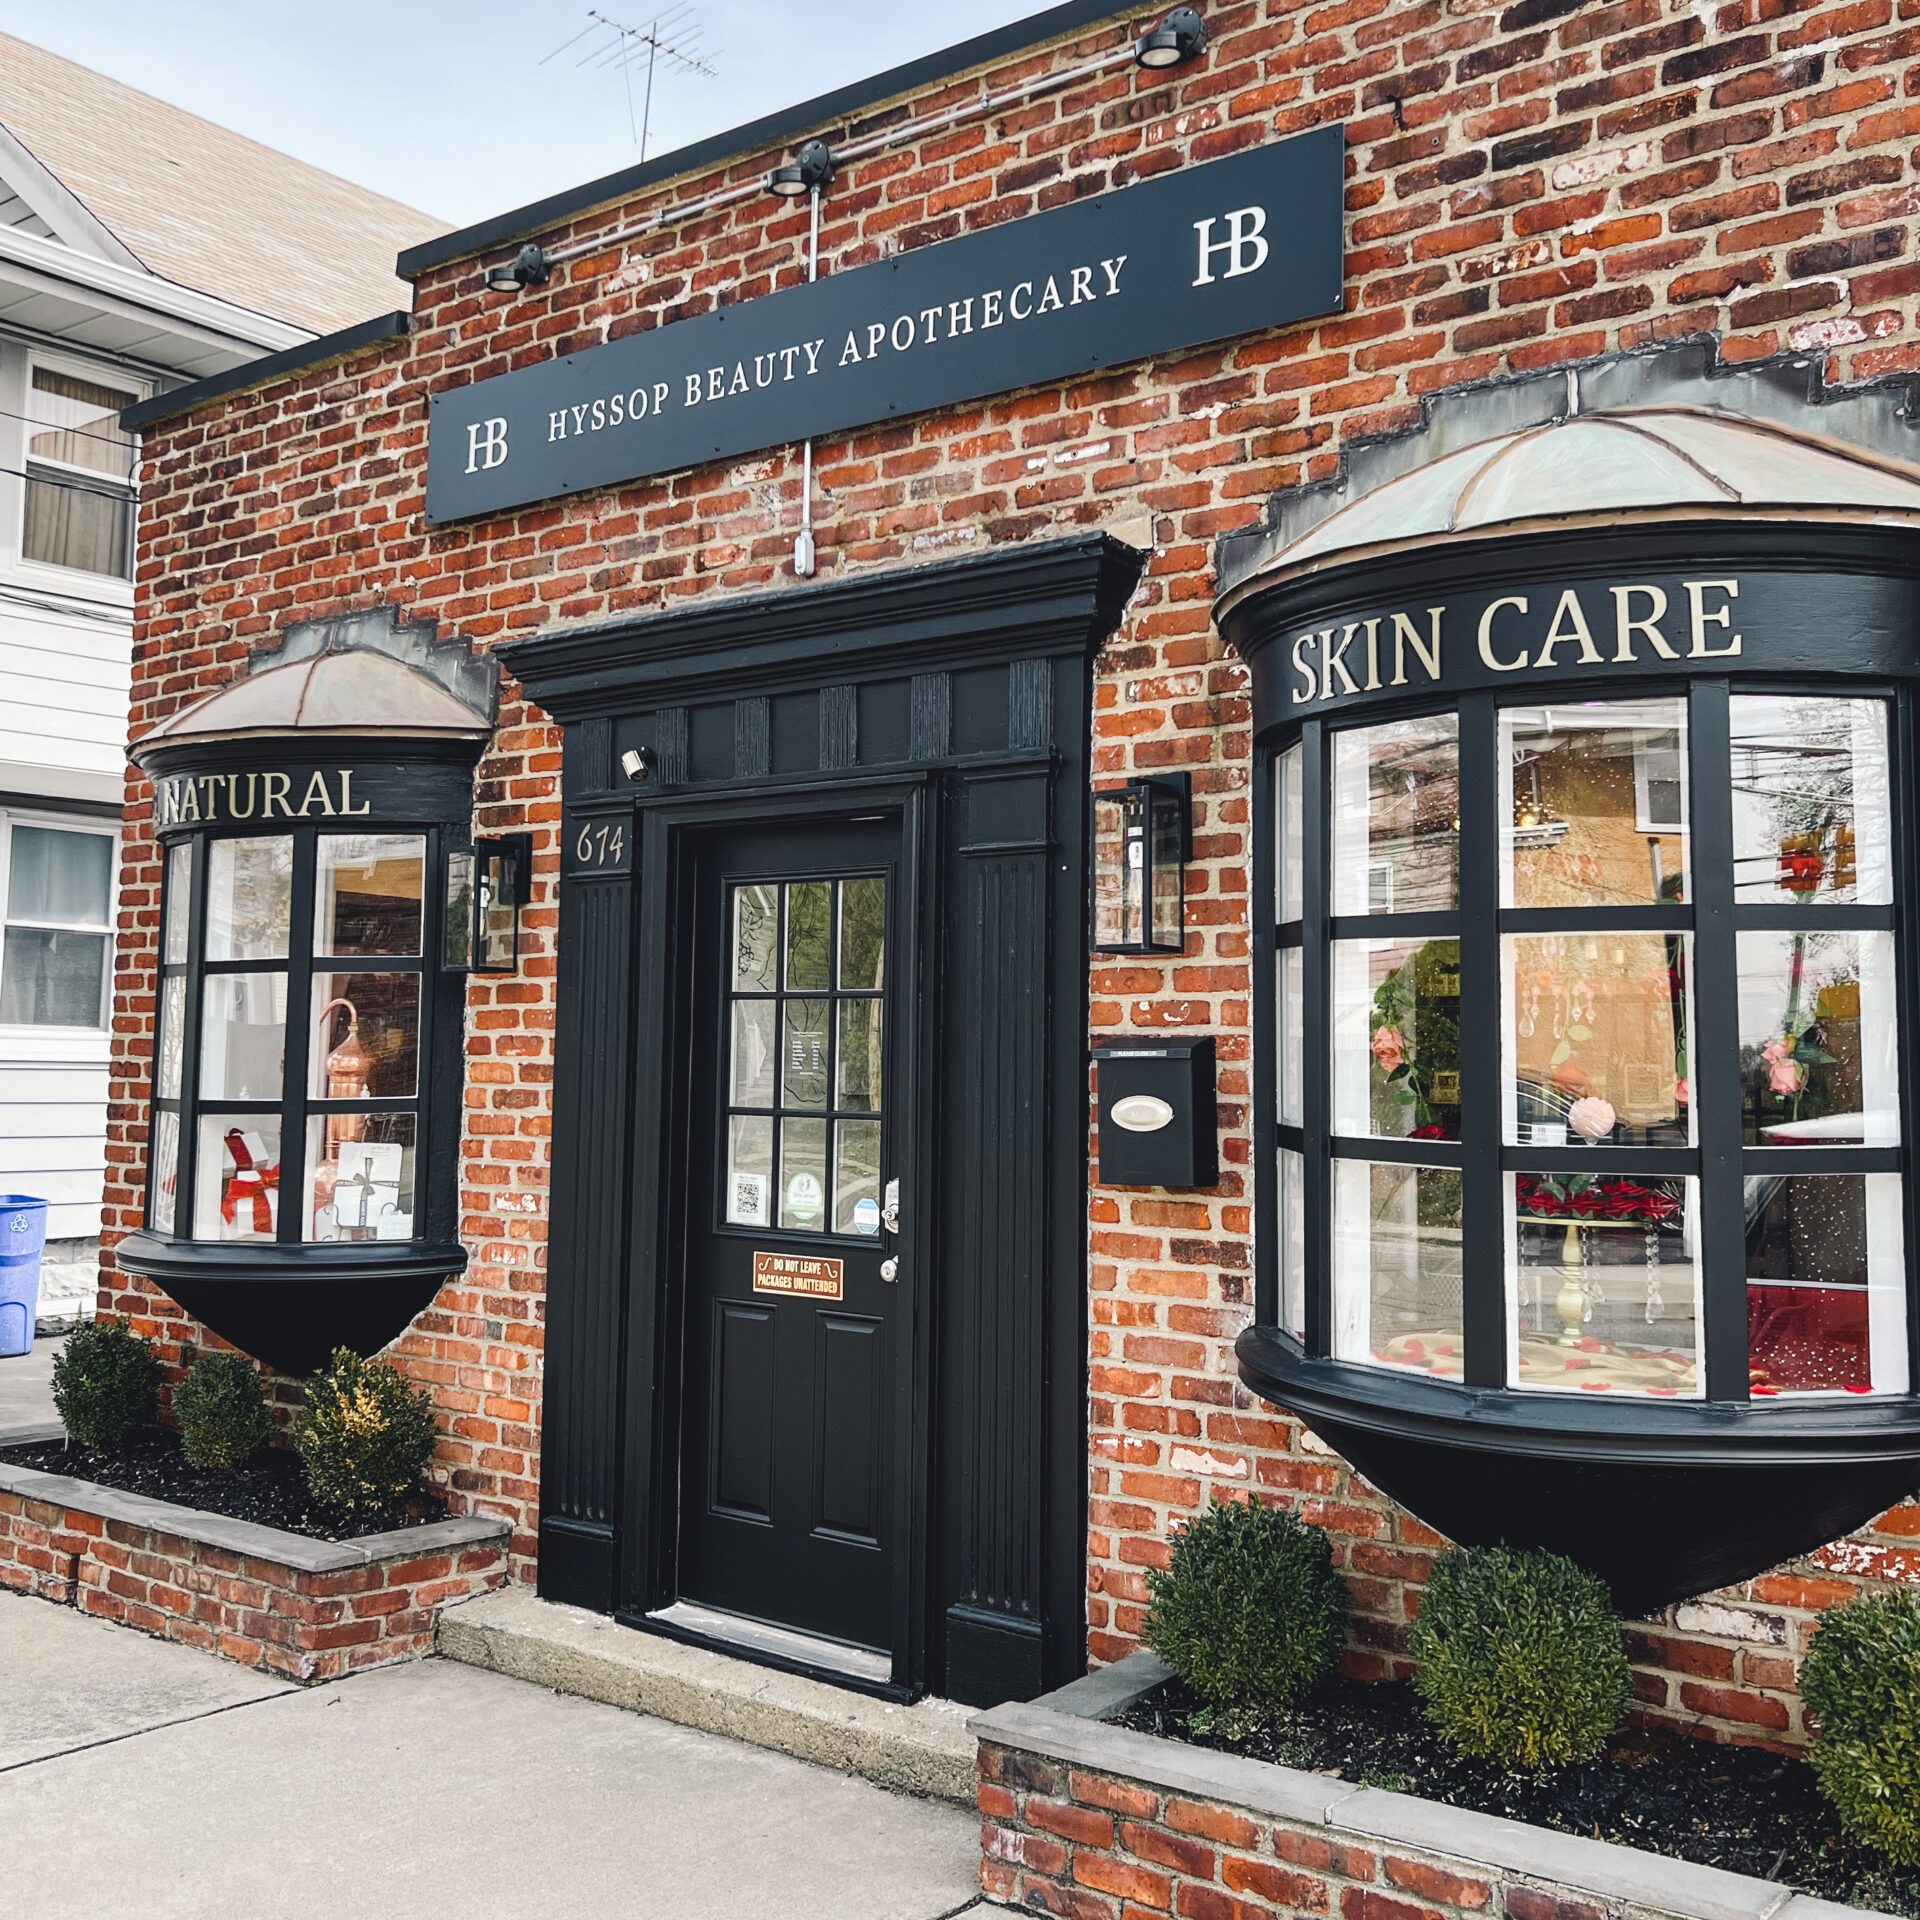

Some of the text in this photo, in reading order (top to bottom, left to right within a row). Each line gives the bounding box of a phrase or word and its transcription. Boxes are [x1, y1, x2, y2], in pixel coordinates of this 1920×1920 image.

[1191, 206, 1269, 287] HB
[547, 255, 1128, 443] HYSSOP BEAUTY APOTHECARY
[464, 416, 508, 475] HB
[1291, 579, 1743, 704] SKIN CARE
[162, 769, 371, 825] NATURAL
[757, 1273, 838, 1294] PACKAGES UNATTENDED
[773, 1258, 822, 1276] DO NOT LEAVE
